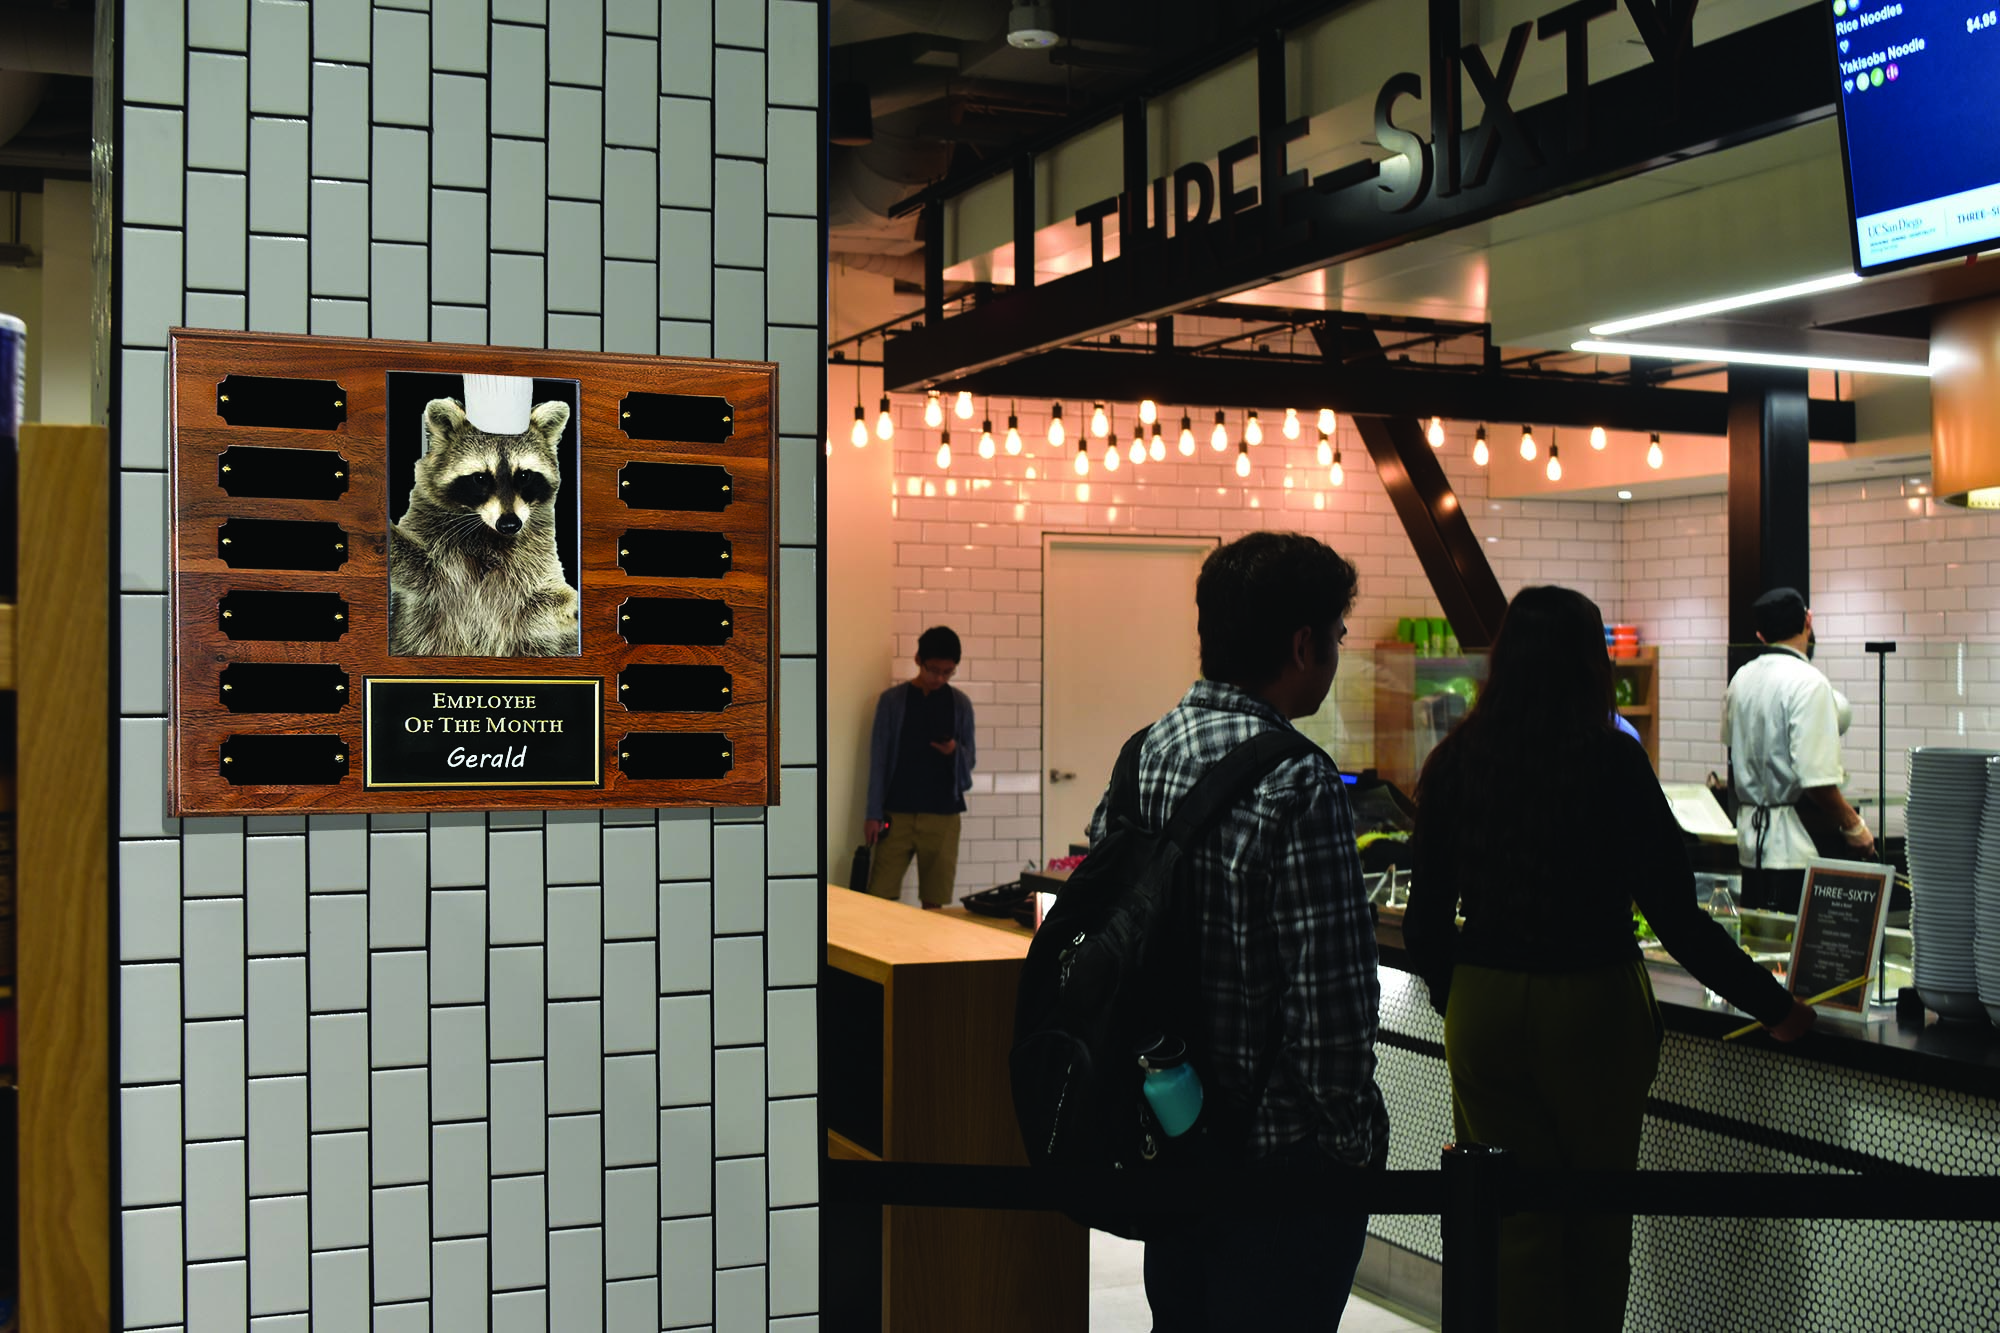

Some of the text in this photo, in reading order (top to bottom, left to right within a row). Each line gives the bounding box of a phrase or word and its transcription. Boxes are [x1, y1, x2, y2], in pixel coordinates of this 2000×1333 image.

[1836, 3, 1903, 36] Rice Noodles
[1966, 10, 1997, 33] $4.95
[1840, 37, 1925, 75] Yakisoba Noodle
[447, 745, 528, 768] Gerald
